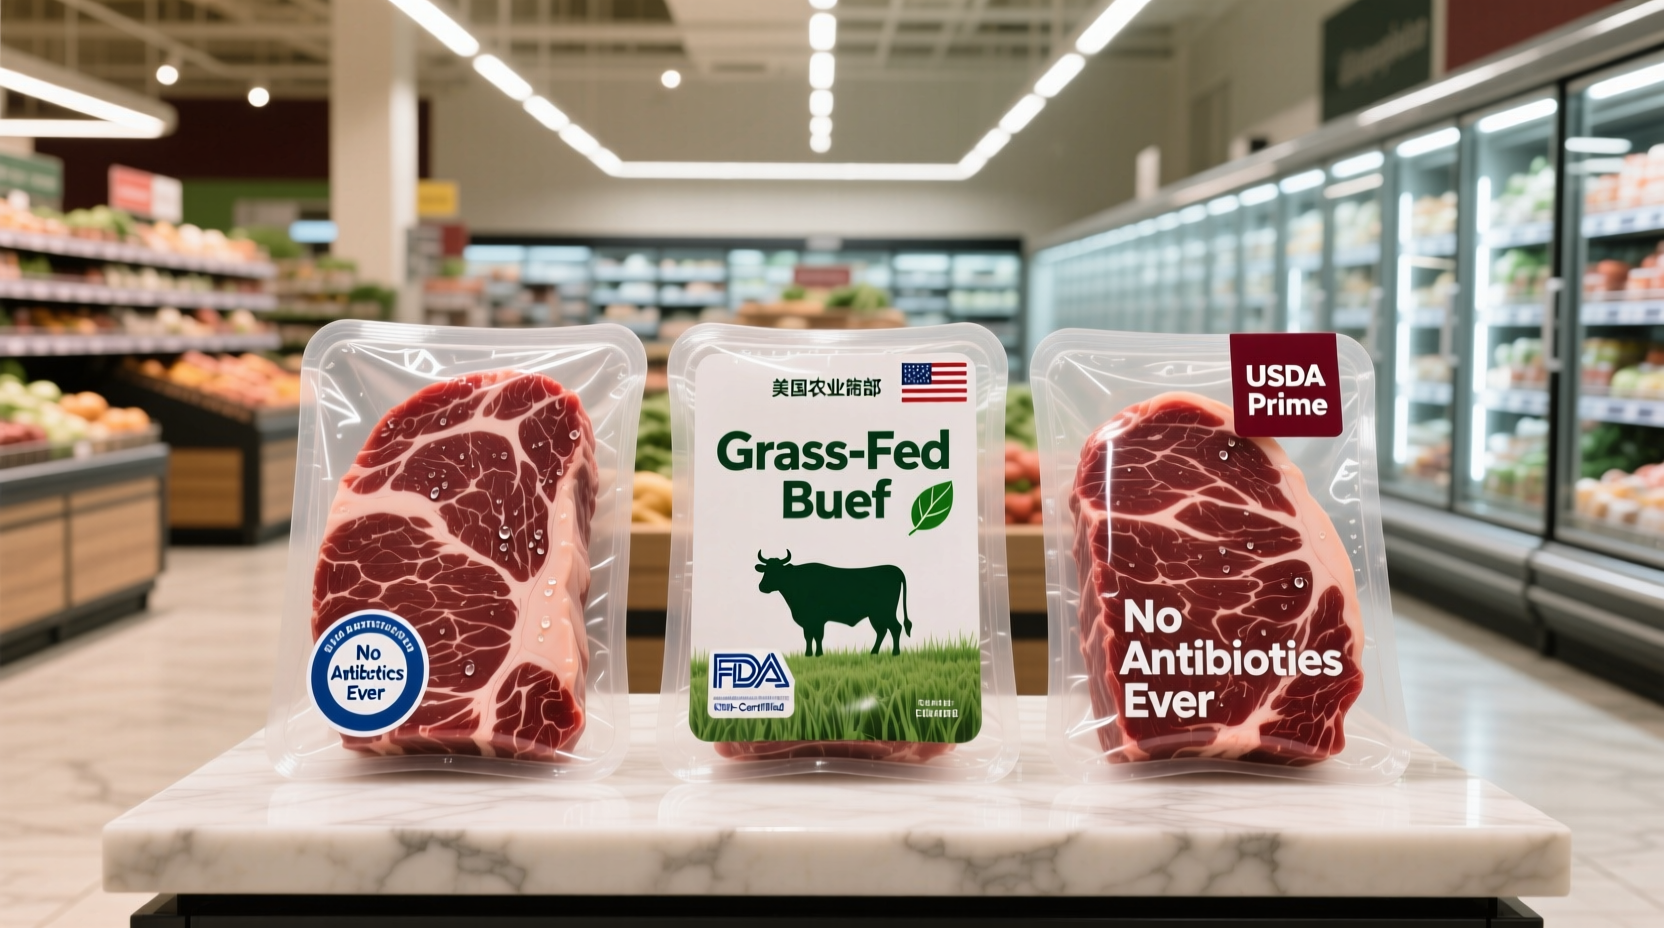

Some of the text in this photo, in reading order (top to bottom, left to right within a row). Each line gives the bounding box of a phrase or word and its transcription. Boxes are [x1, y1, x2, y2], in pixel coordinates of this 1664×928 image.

[1246, 364, 1326, 387] USDA
[1249, 391, 1328, 416] Prime
[717, 429, 950, 472] Grass-Fed
[783, 479, 892, 519] Buef
[1124, 598, 1182, 634] No
[356, 645, 381, 660] No
[1119, 639, 1343, 677] Antibioties
[713, 653, 790, 688] FDA
[347, 685, 386, 700] Ever
[1125, 683, 1215, 718] Ever
